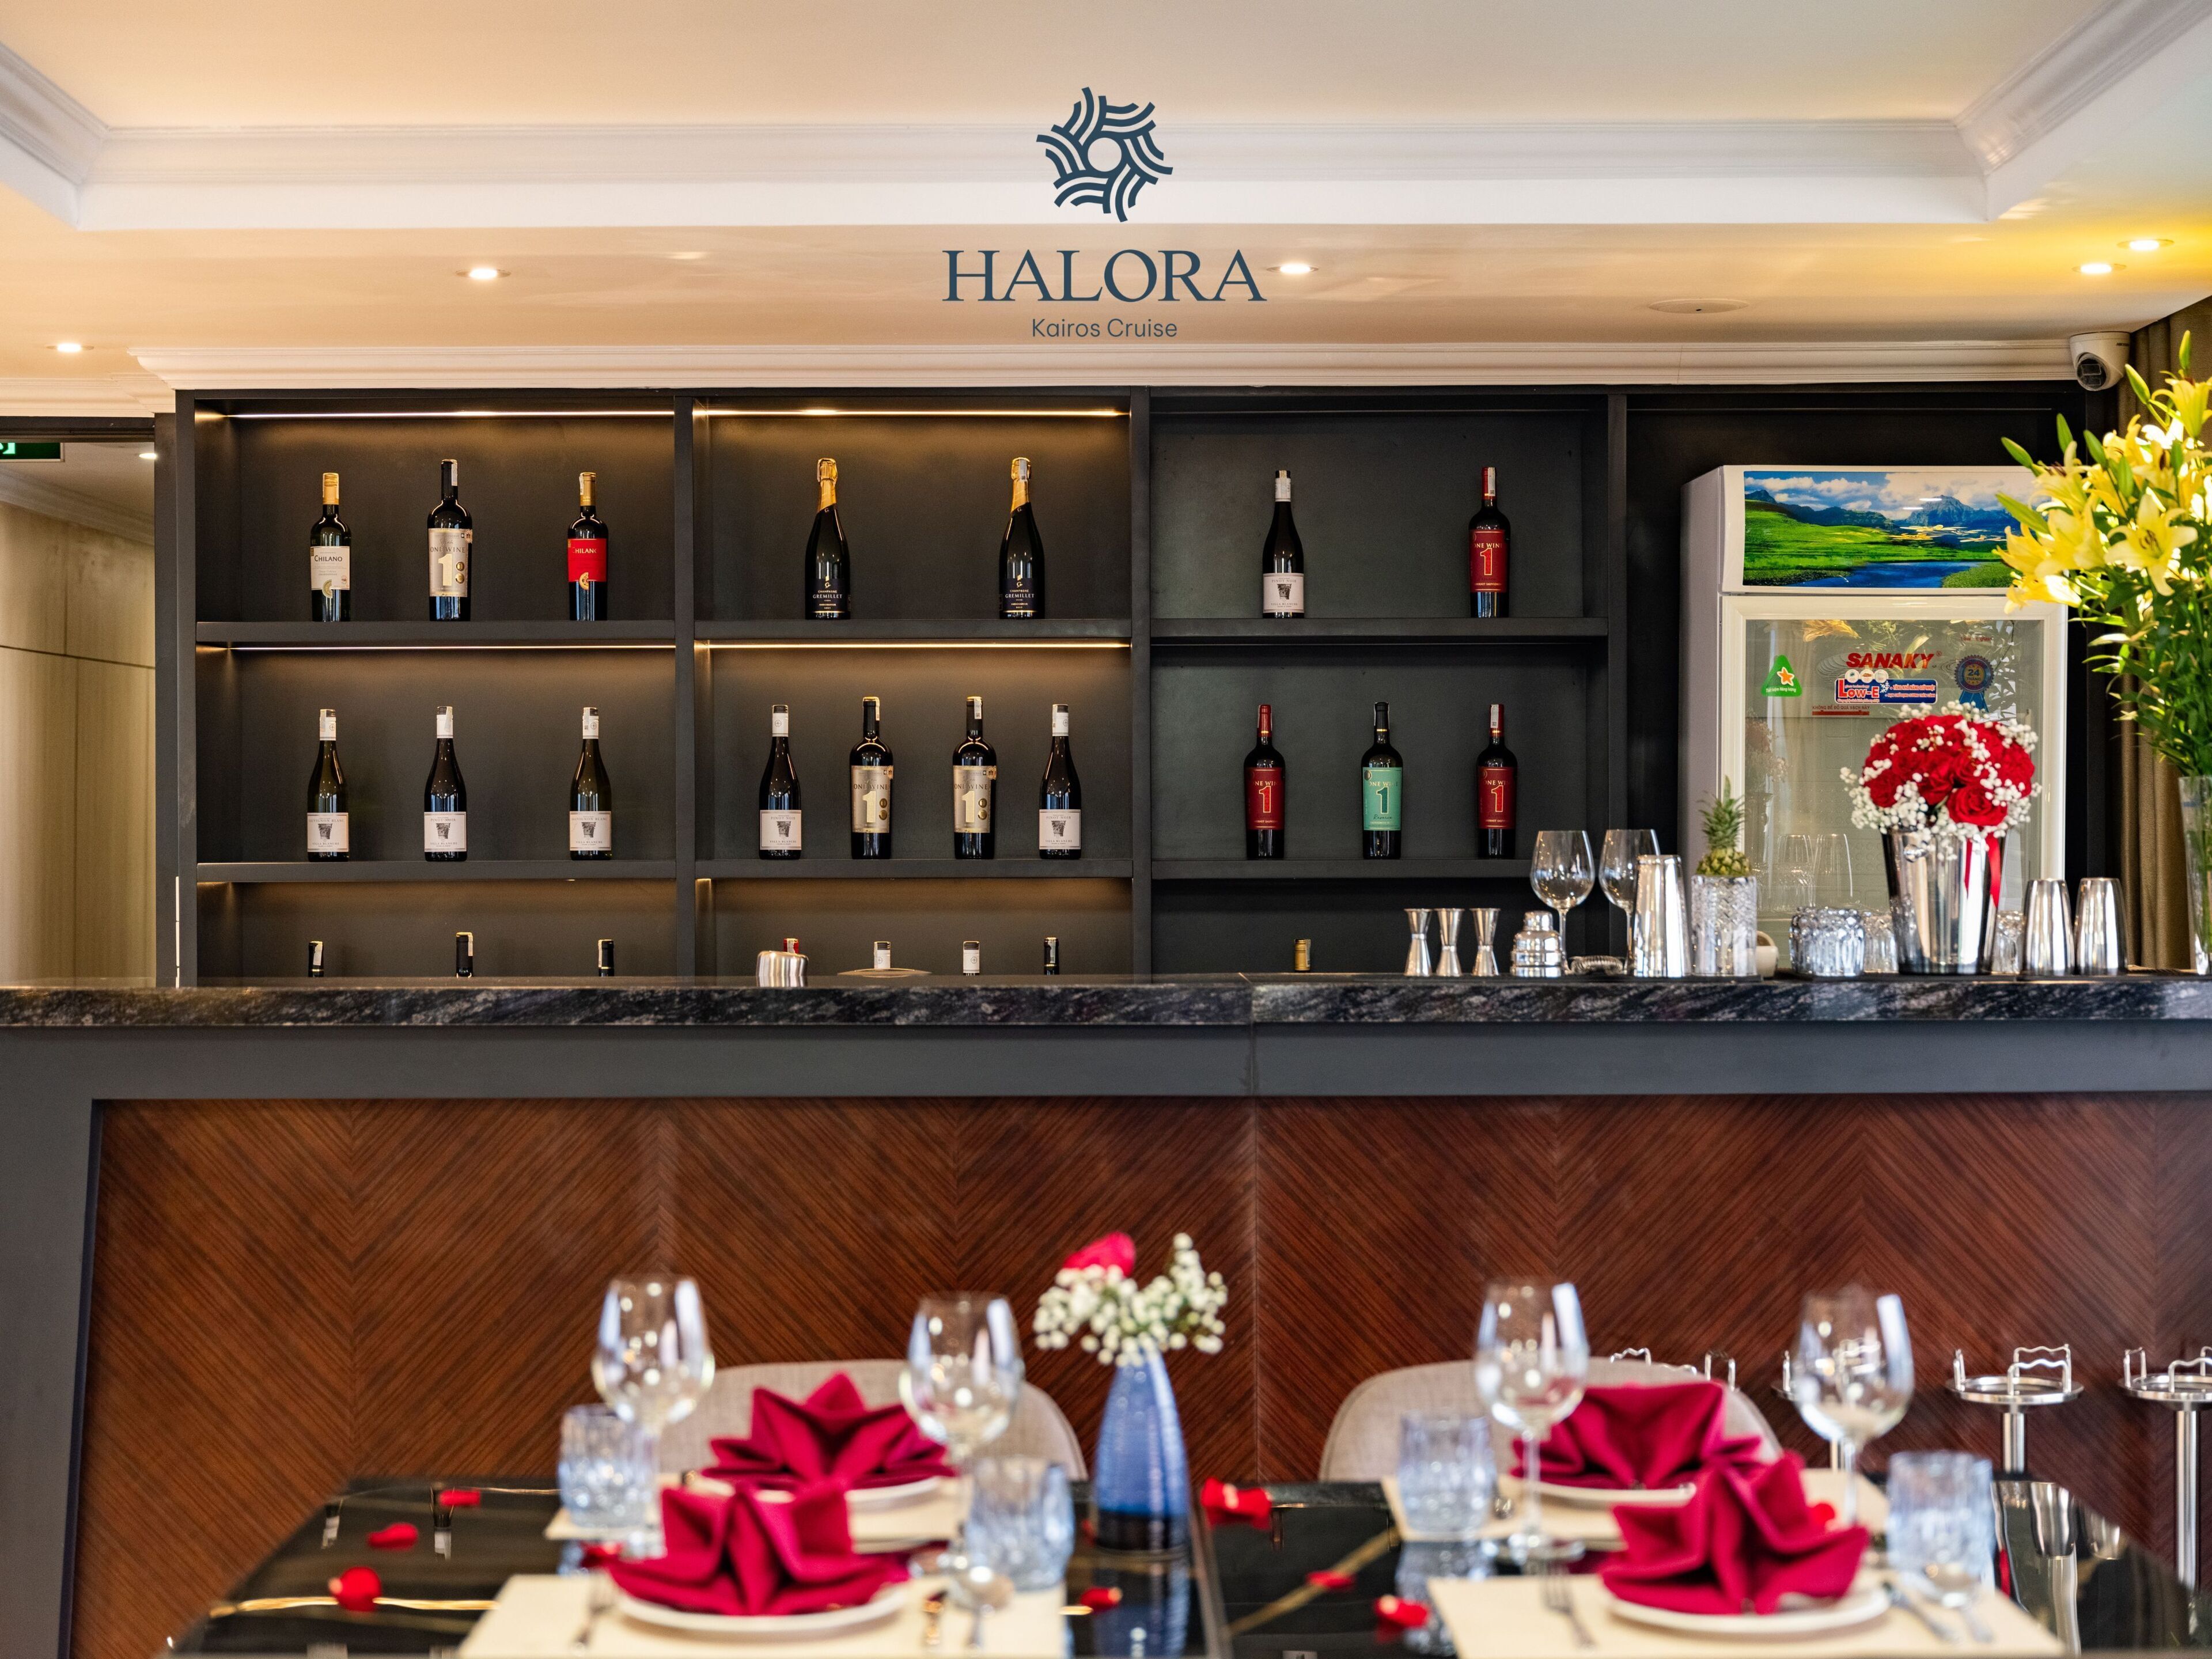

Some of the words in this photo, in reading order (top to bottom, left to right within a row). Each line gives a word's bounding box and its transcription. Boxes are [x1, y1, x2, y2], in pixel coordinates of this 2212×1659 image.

[438, 554, 452, 586] 1
[1480, 547, 1493, 575] 1
[1846, 653, 1934, 669] SANAKY
[862, 790, 876, 823] 1
[961, 791, 975, 823] 1
[1259, 786, 1271, 813] 1
[1376, 786, 1389, 814] 1
[1491, 785, 1503, 812] 1
